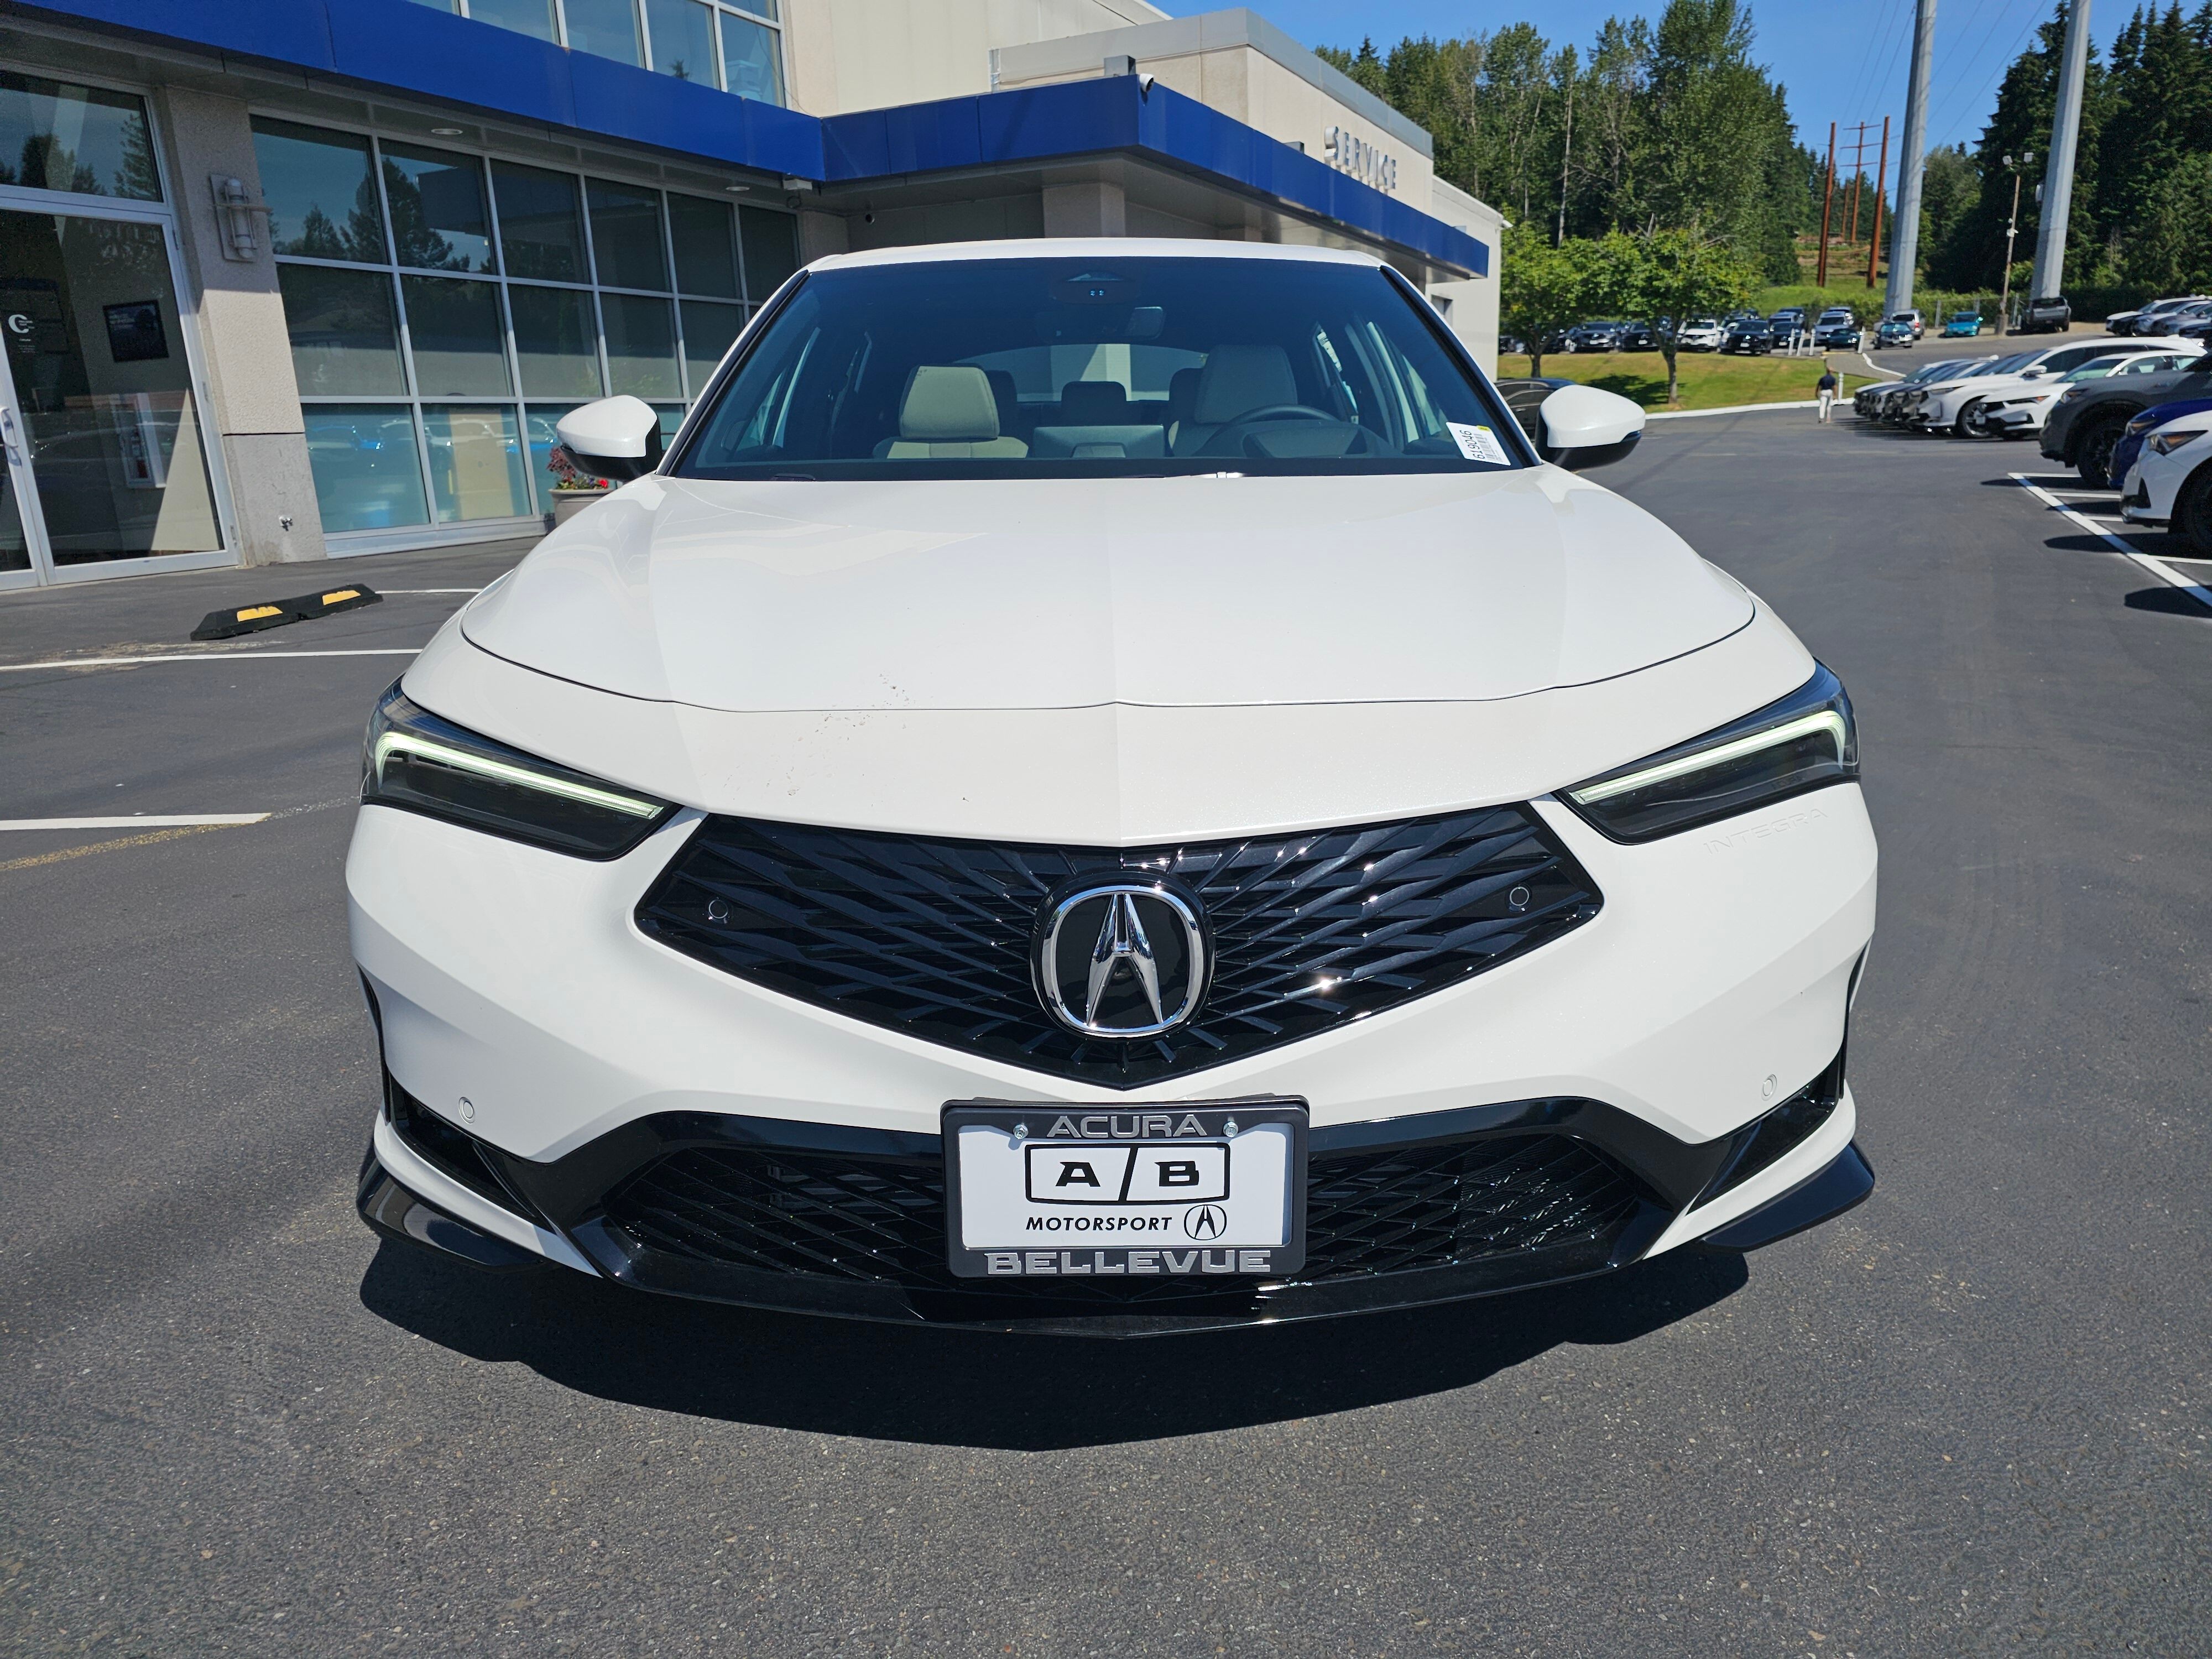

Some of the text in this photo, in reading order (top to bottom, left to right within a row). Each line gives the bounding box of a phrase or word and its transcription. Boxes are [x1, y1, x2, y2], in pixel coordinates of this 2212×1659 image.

[1324, 126, 1396, 191] SERVICE
[1459, 430, 1485, 459] 619046
[1703, 808, 1828, 855] INTEGRA
[1046, 1114, 1207, 1139] ACURA
[1055, 1161, 1199, 1187] A B
[1026, 1216, 1172, 1231] MOTORSPORT
[983, 1250, 1271, 1275] BELLEVUE
